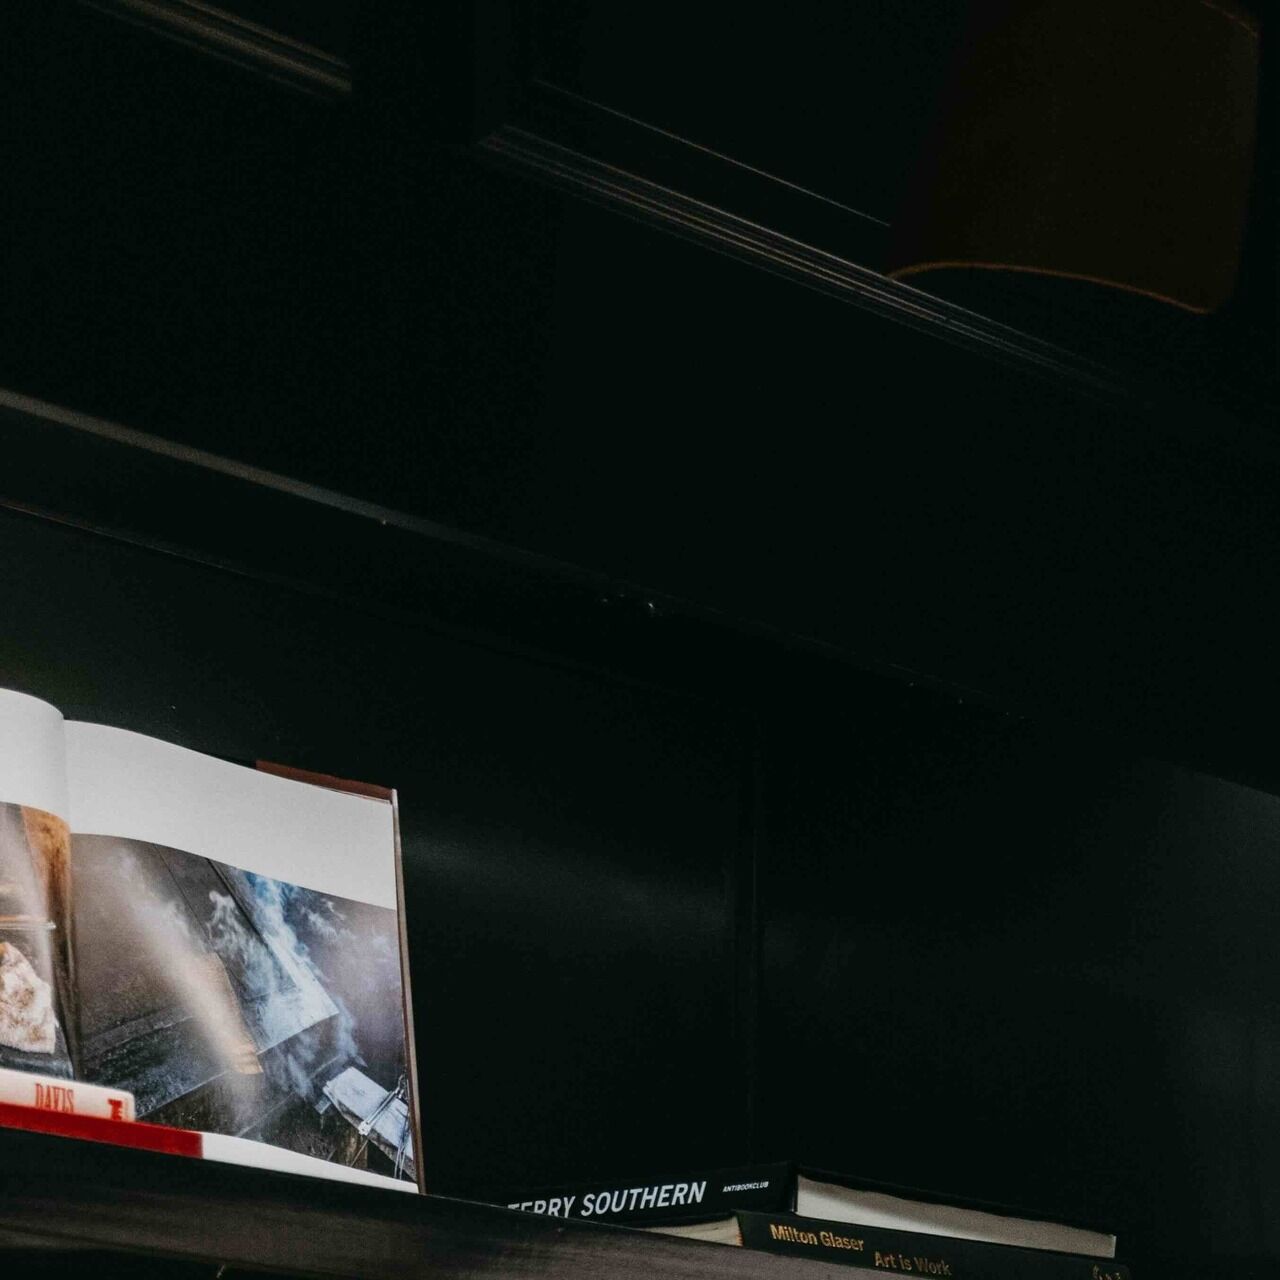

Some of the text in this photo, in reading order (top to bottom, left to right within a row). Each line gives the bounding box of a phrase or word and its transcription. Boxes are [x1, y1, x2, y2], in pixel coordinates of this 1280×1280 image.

[35, 1083, 74, 1114] DAVIS
[507, 1181, 707, 1218] RRY SOUTHERN
[722, 1181, 769, 1193] ANTIBOOKCLUB
[769, 1223, 864, 1252] Milton Glaser
[873, 1251, 952, 1277] Art is Work
